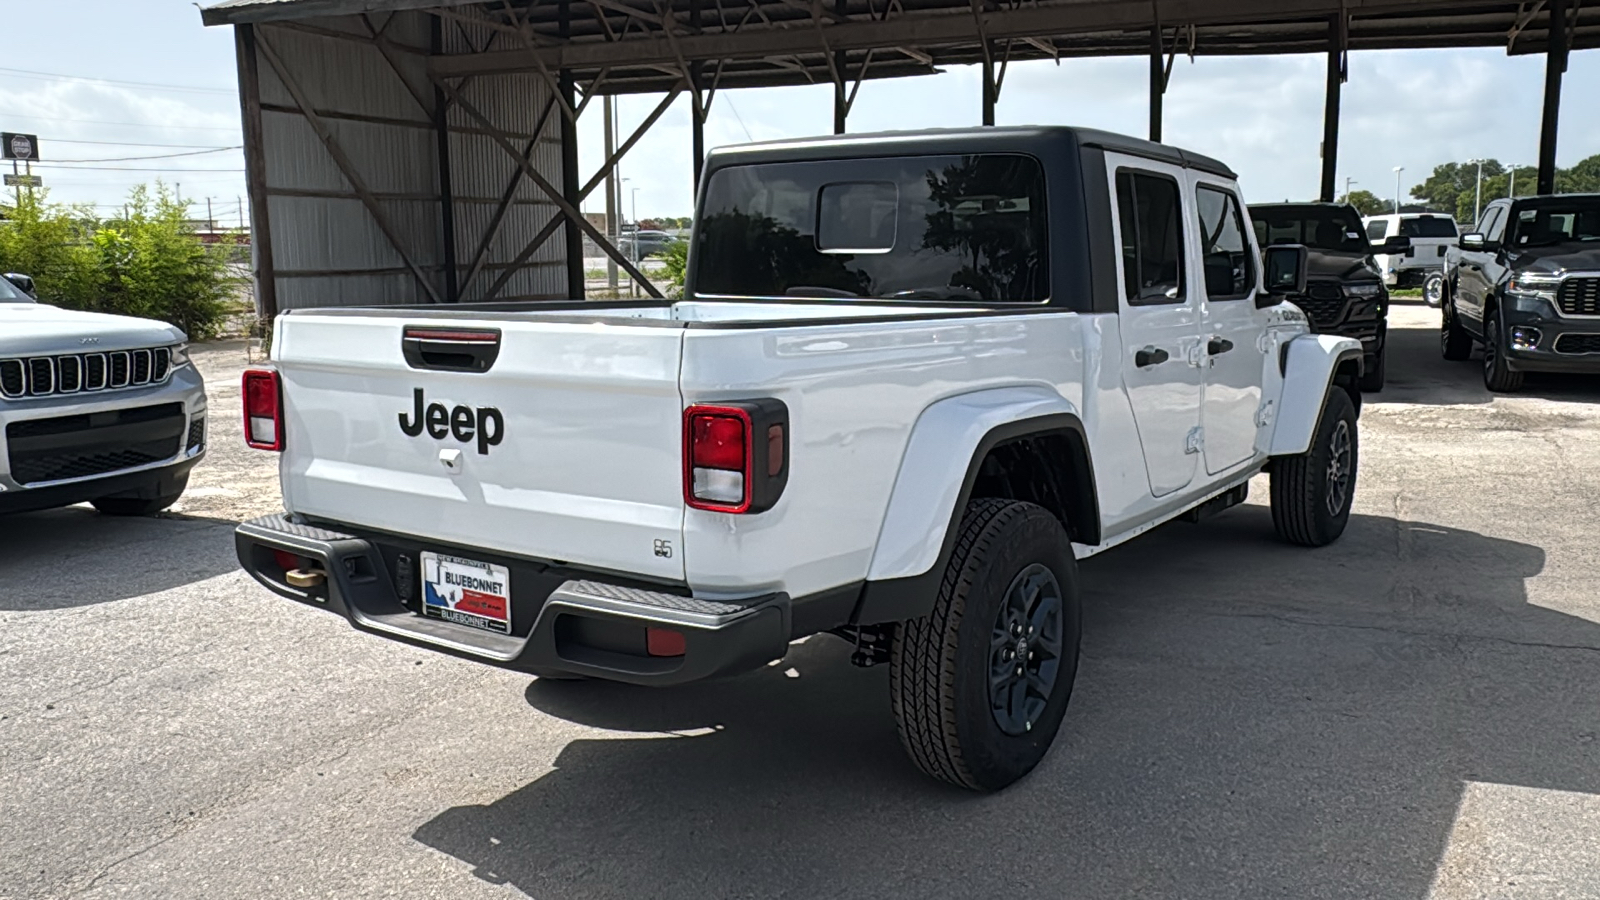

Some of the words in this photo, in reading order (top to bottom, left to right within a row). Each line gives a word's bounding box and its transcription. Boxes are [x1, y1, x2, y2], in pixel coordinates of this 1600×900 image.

[398, 387, 504, 455] Jeep
[445, 571, 503, 595] BLUEBONNET
[441, 610, 489, 629] BLUEBONNET
